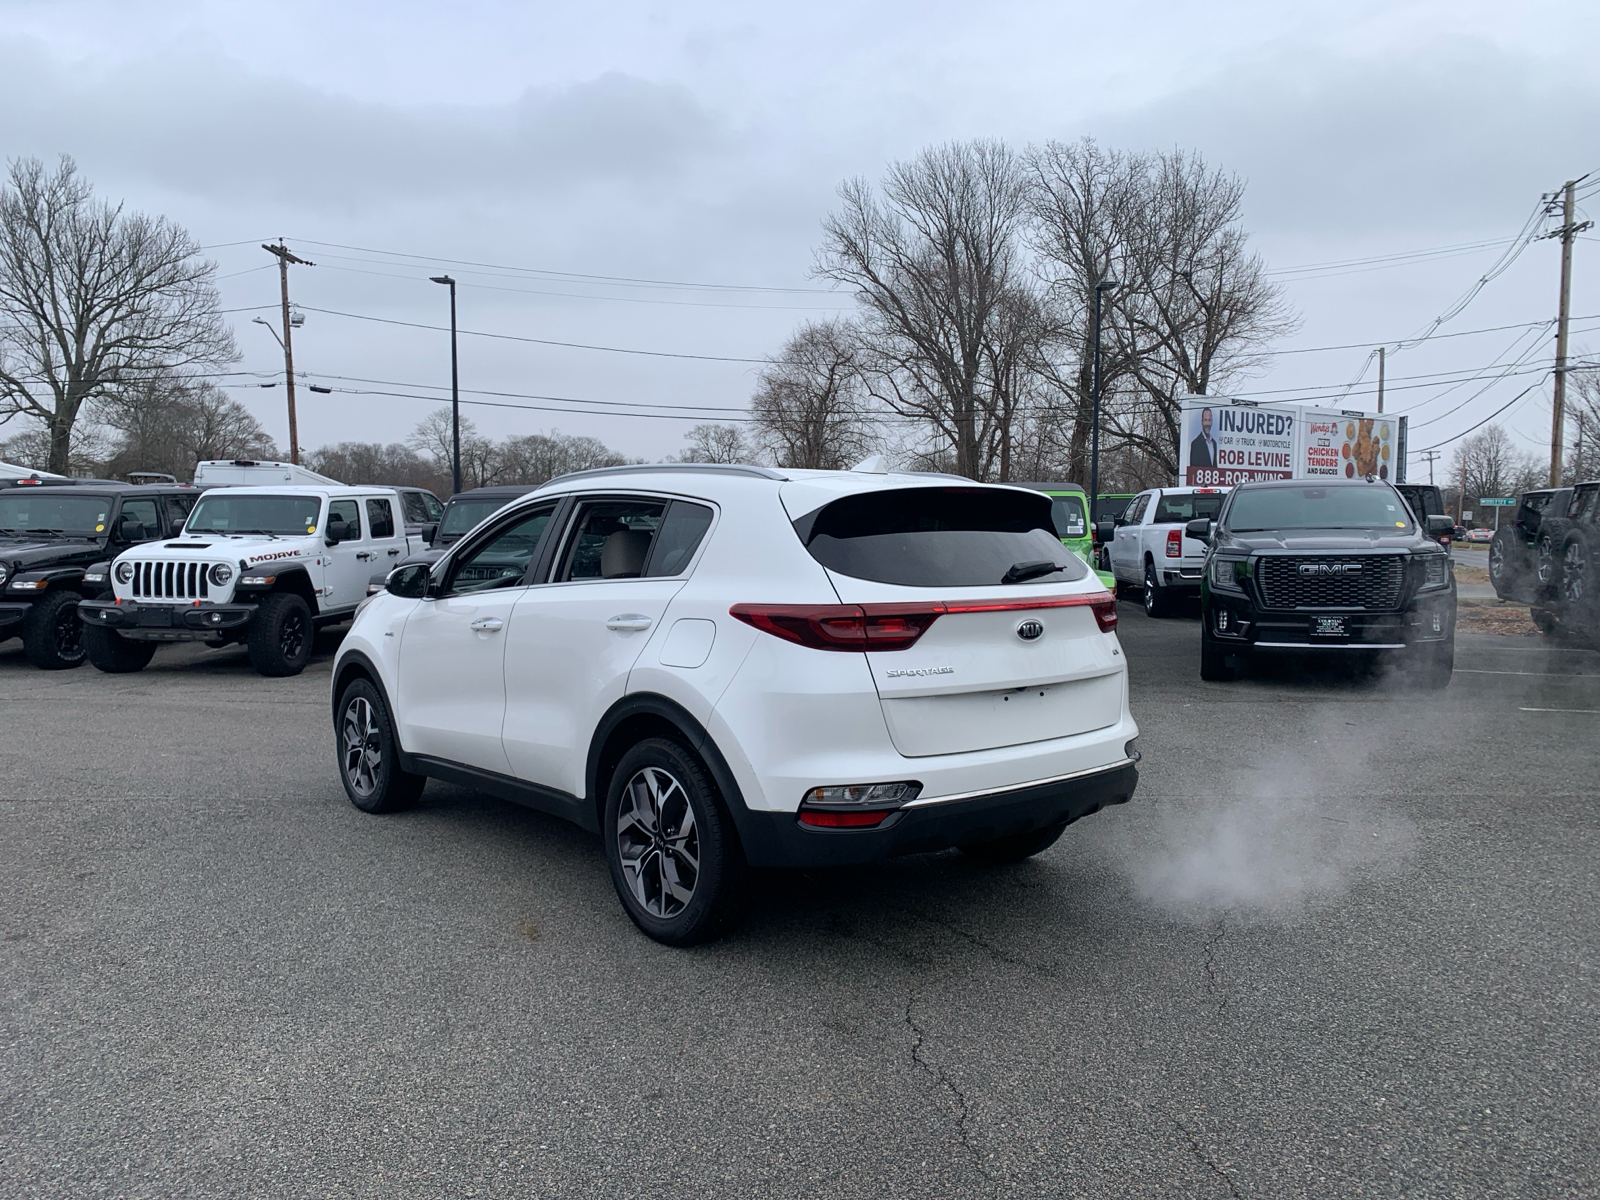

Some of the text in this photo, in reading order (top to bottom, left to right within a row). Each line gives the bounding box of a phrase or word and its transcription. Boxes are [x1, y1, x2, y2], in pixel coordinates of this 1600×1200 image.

[1219, 410, 1293, 437] INJURED?
[1310, 422, 1330, 435] Wendy's
[1223, 437, 1291, 449] CAR TRUCK MOTORCYCLE
[1308, 447, 1339, 457] CHICKEN
[1218, 449, 1291, 468] ROB LEVINE
[1308, 457, 1338, 467] TENDERS
[249, 550, 301, 562] MOJAVE
[1300, 564, 1362, 576] GMC
[1022, 624, 1041, 637] KIA
[886, 666, 954, 678] SPORTAGE
